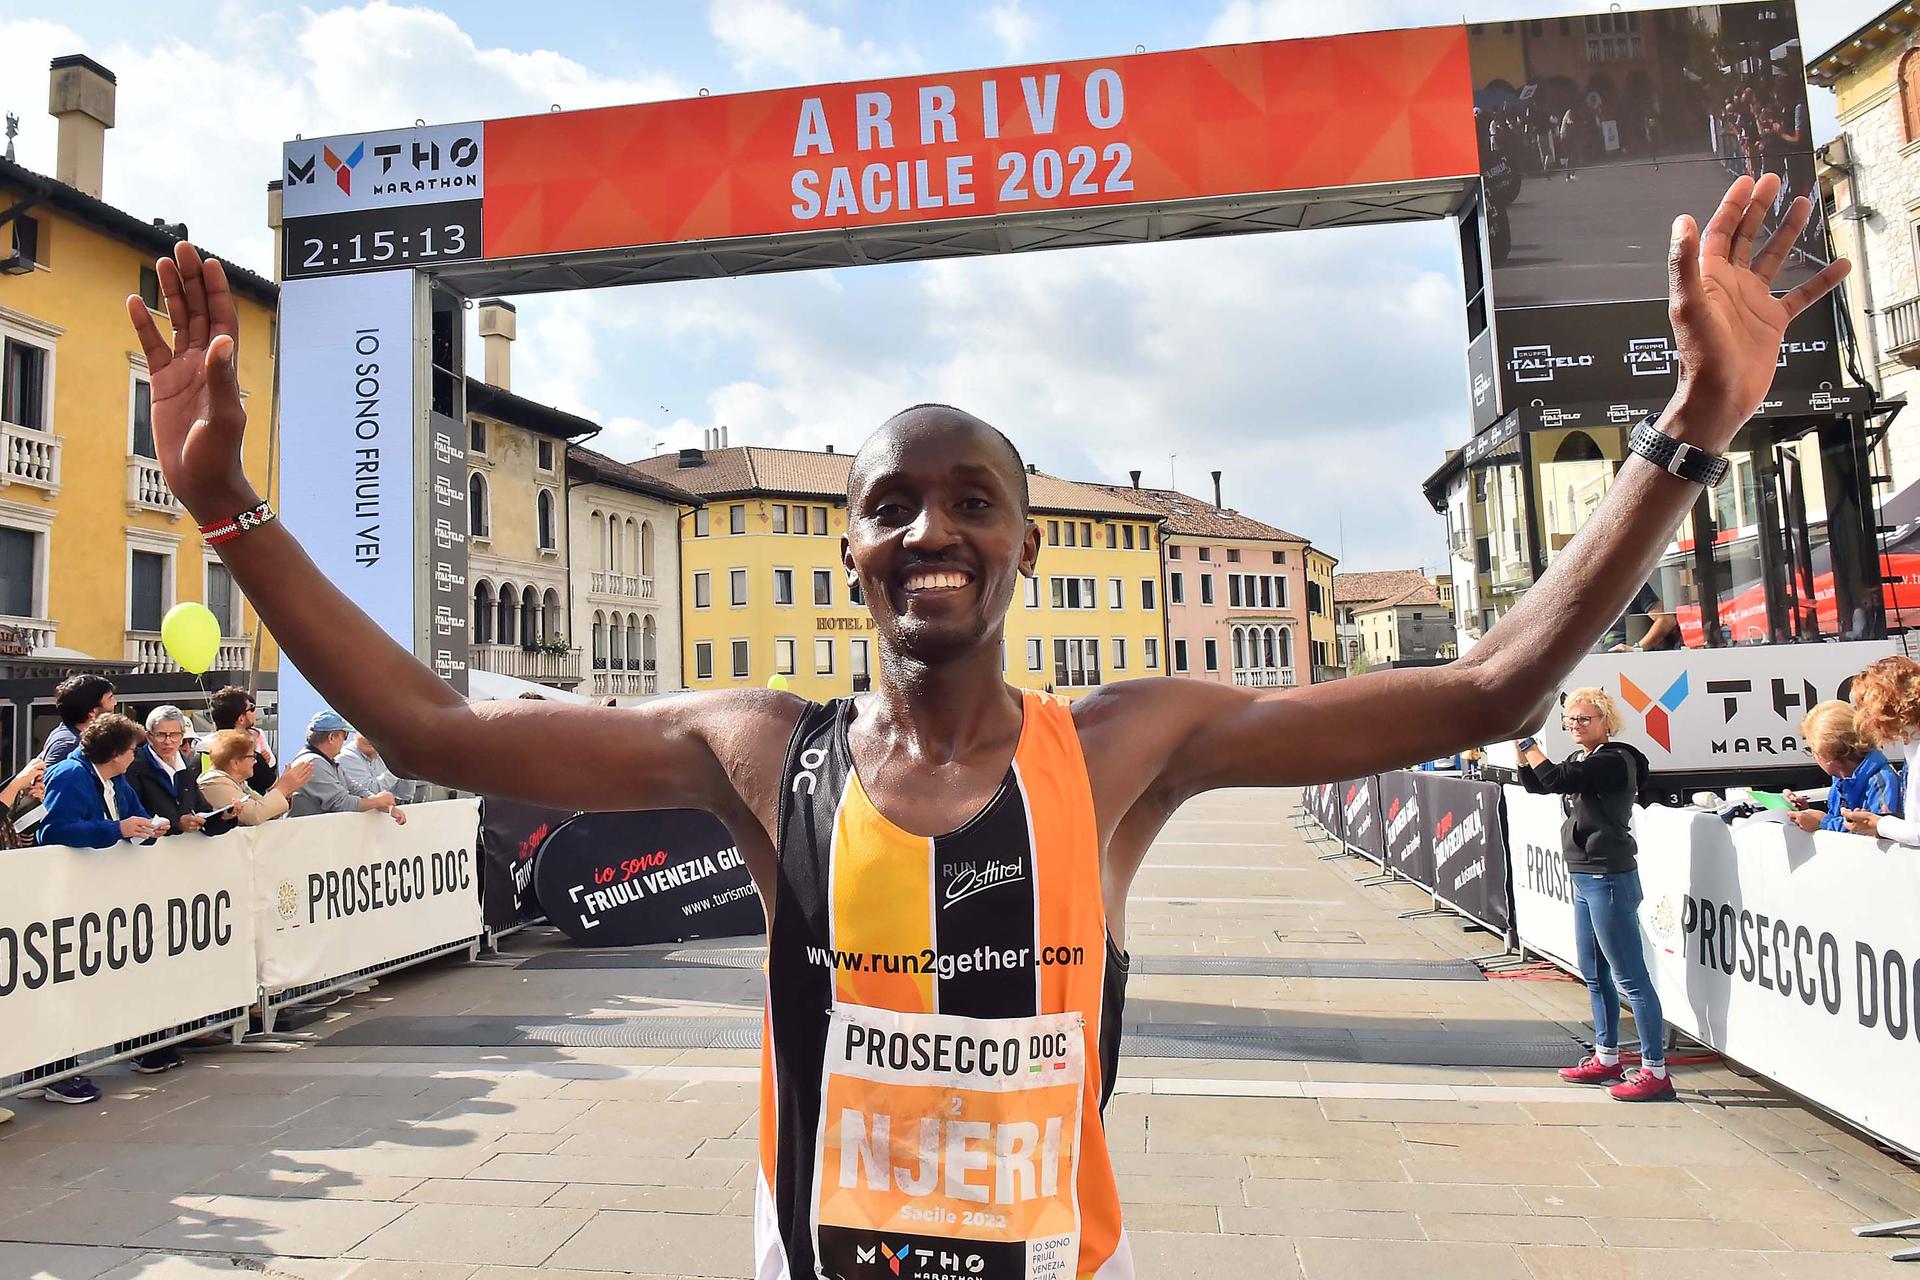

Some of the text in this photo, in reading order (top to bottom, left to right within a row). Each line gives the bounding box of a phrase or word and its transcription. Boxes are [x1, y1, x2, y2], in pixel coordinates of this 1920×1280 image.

[793, 68, 1125, 157] ARRIVO
[288, 137, 478, 197] MYTHO
[374, 174, 477, 195] MARATHON
[791, 142, 1134, 220] SACILE 2022
[303, 224, 466, 268] 2:15:13
[355, 328, 380, 356] IO
[355, 363, 380, 440] SONO
[355, 448, 380, 518] FRIULI
[816, 617, 863, 630] HOTEL
[1711, 736, 1804, 755] MARA
[1670, 795, 1679, 804] 3
[308, 855, 425, 924] PROSECCO
[432, 848, 470, 895] DOC
[584, 878, 645, 915] FRIULI
[644, 856, 718, 894] VENEZIA
[594, 850, 668, 884] io sono
[943, 860, 976, 878] RUN
[945, 856, 1022, 899] Osttirol
[1527, 844, 1574, 905] PROSE
[167, 889, 232, 957] DOC
[1681, 894, 1841, 1015] PROSECCO
[845, 1023, 1067, 1077] PROSECCO DOC
[951, 1097, 963, 1116] 2
[838, 1107, 1063, 1205] NJERI
[900, 1205, 1007, 1229] Sacile 2022
[856, 1241, 985, 1277] MYTHO
[1033, 1237, 1070, 1252] IO SONO
[1033, 1251, 1055, 1264] FRIULI
[1032, 1261, 1066, 1274] VENEZIA
